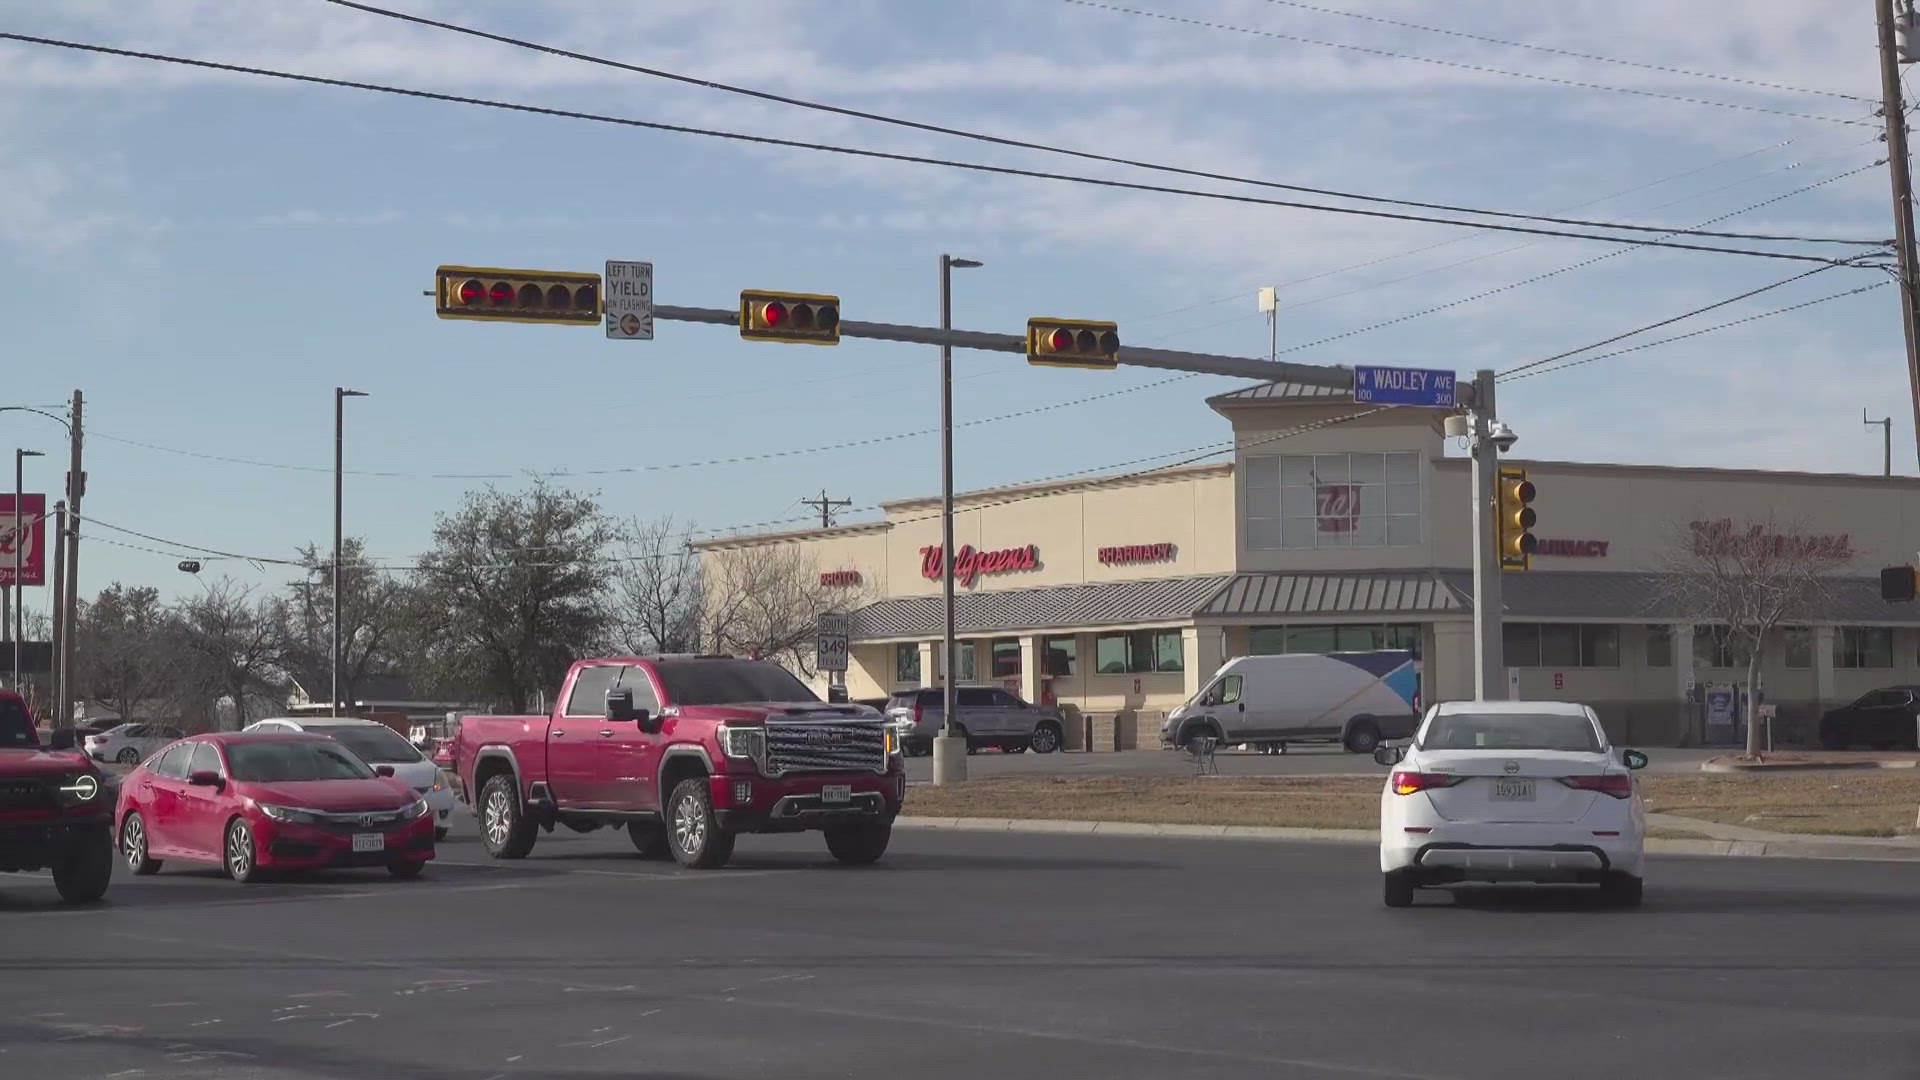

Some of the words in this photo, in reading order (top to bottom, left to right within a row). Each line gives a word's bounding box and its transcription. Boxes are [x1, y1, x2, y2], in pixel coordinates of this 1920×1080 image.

[608, 265, 626, 277] LEFT
[631, 266, 650, 279] TURN
[610, 281, 648, 296] YIELD
[620, 300, 650, 311] FLASHING
[1358, 371, 1366, 385] W
[1373, 369, 1428, 391] WADLEY
[1434, 376, 1452, 390] AVE
[1358, 389, 1372, 400] 100
[1435, 393, 1452, 404] 300
[1097, 544, 1172, 563] PHARMACY
[919, 545, 1037, 588] Wlgreens
[820, 571, 858, 587] PHOTO
[820, 617, 847, 631] SOUTH
[820, 640, 846, 655] 349
[822, 658, 844, 667] TEXAS
